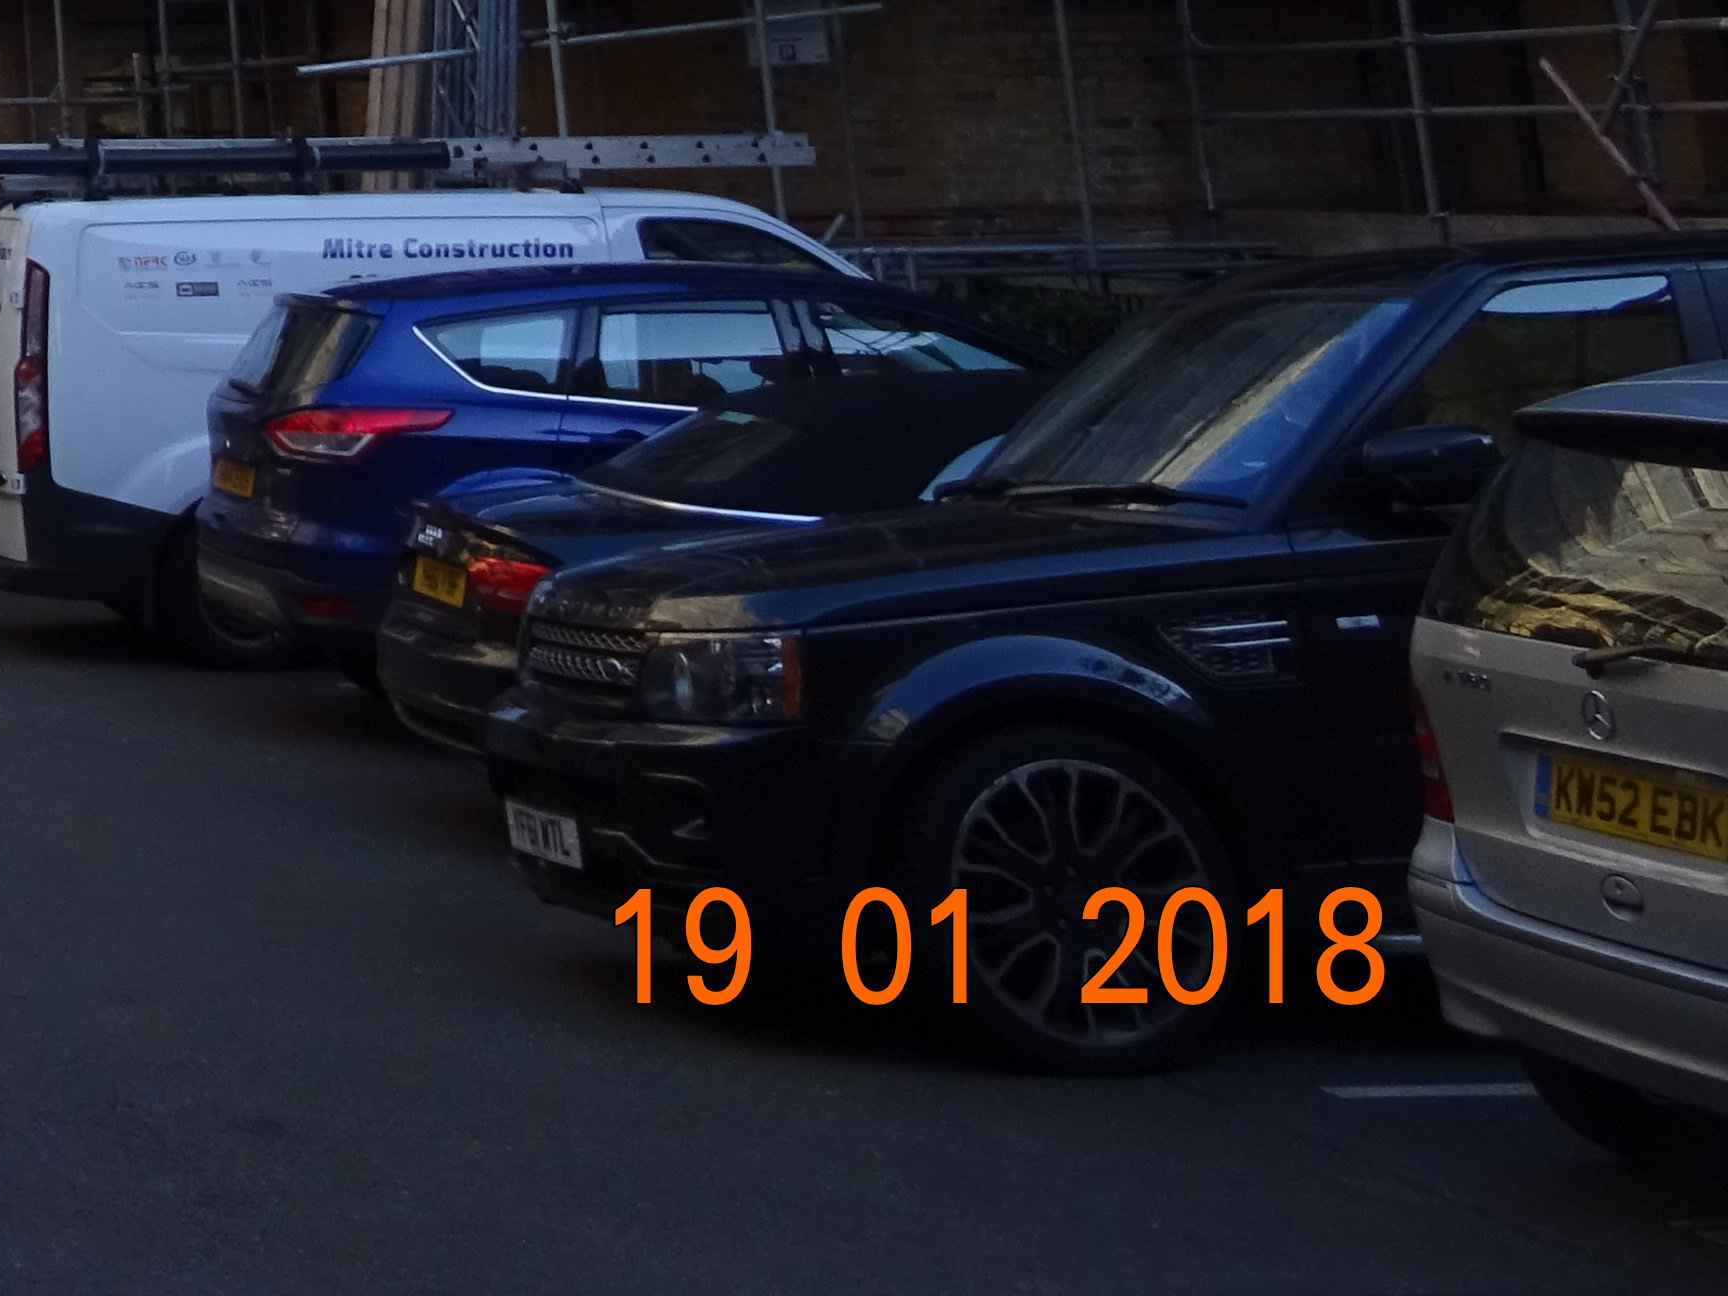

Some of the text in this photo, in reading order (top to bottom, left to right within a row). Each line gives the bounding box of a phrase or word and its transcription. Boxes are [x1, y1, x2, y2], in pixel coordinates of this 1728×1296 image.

[322, 237, 574, 259] Mitre Construction
[1554, 763, 1726, 847] KW52 EBK
